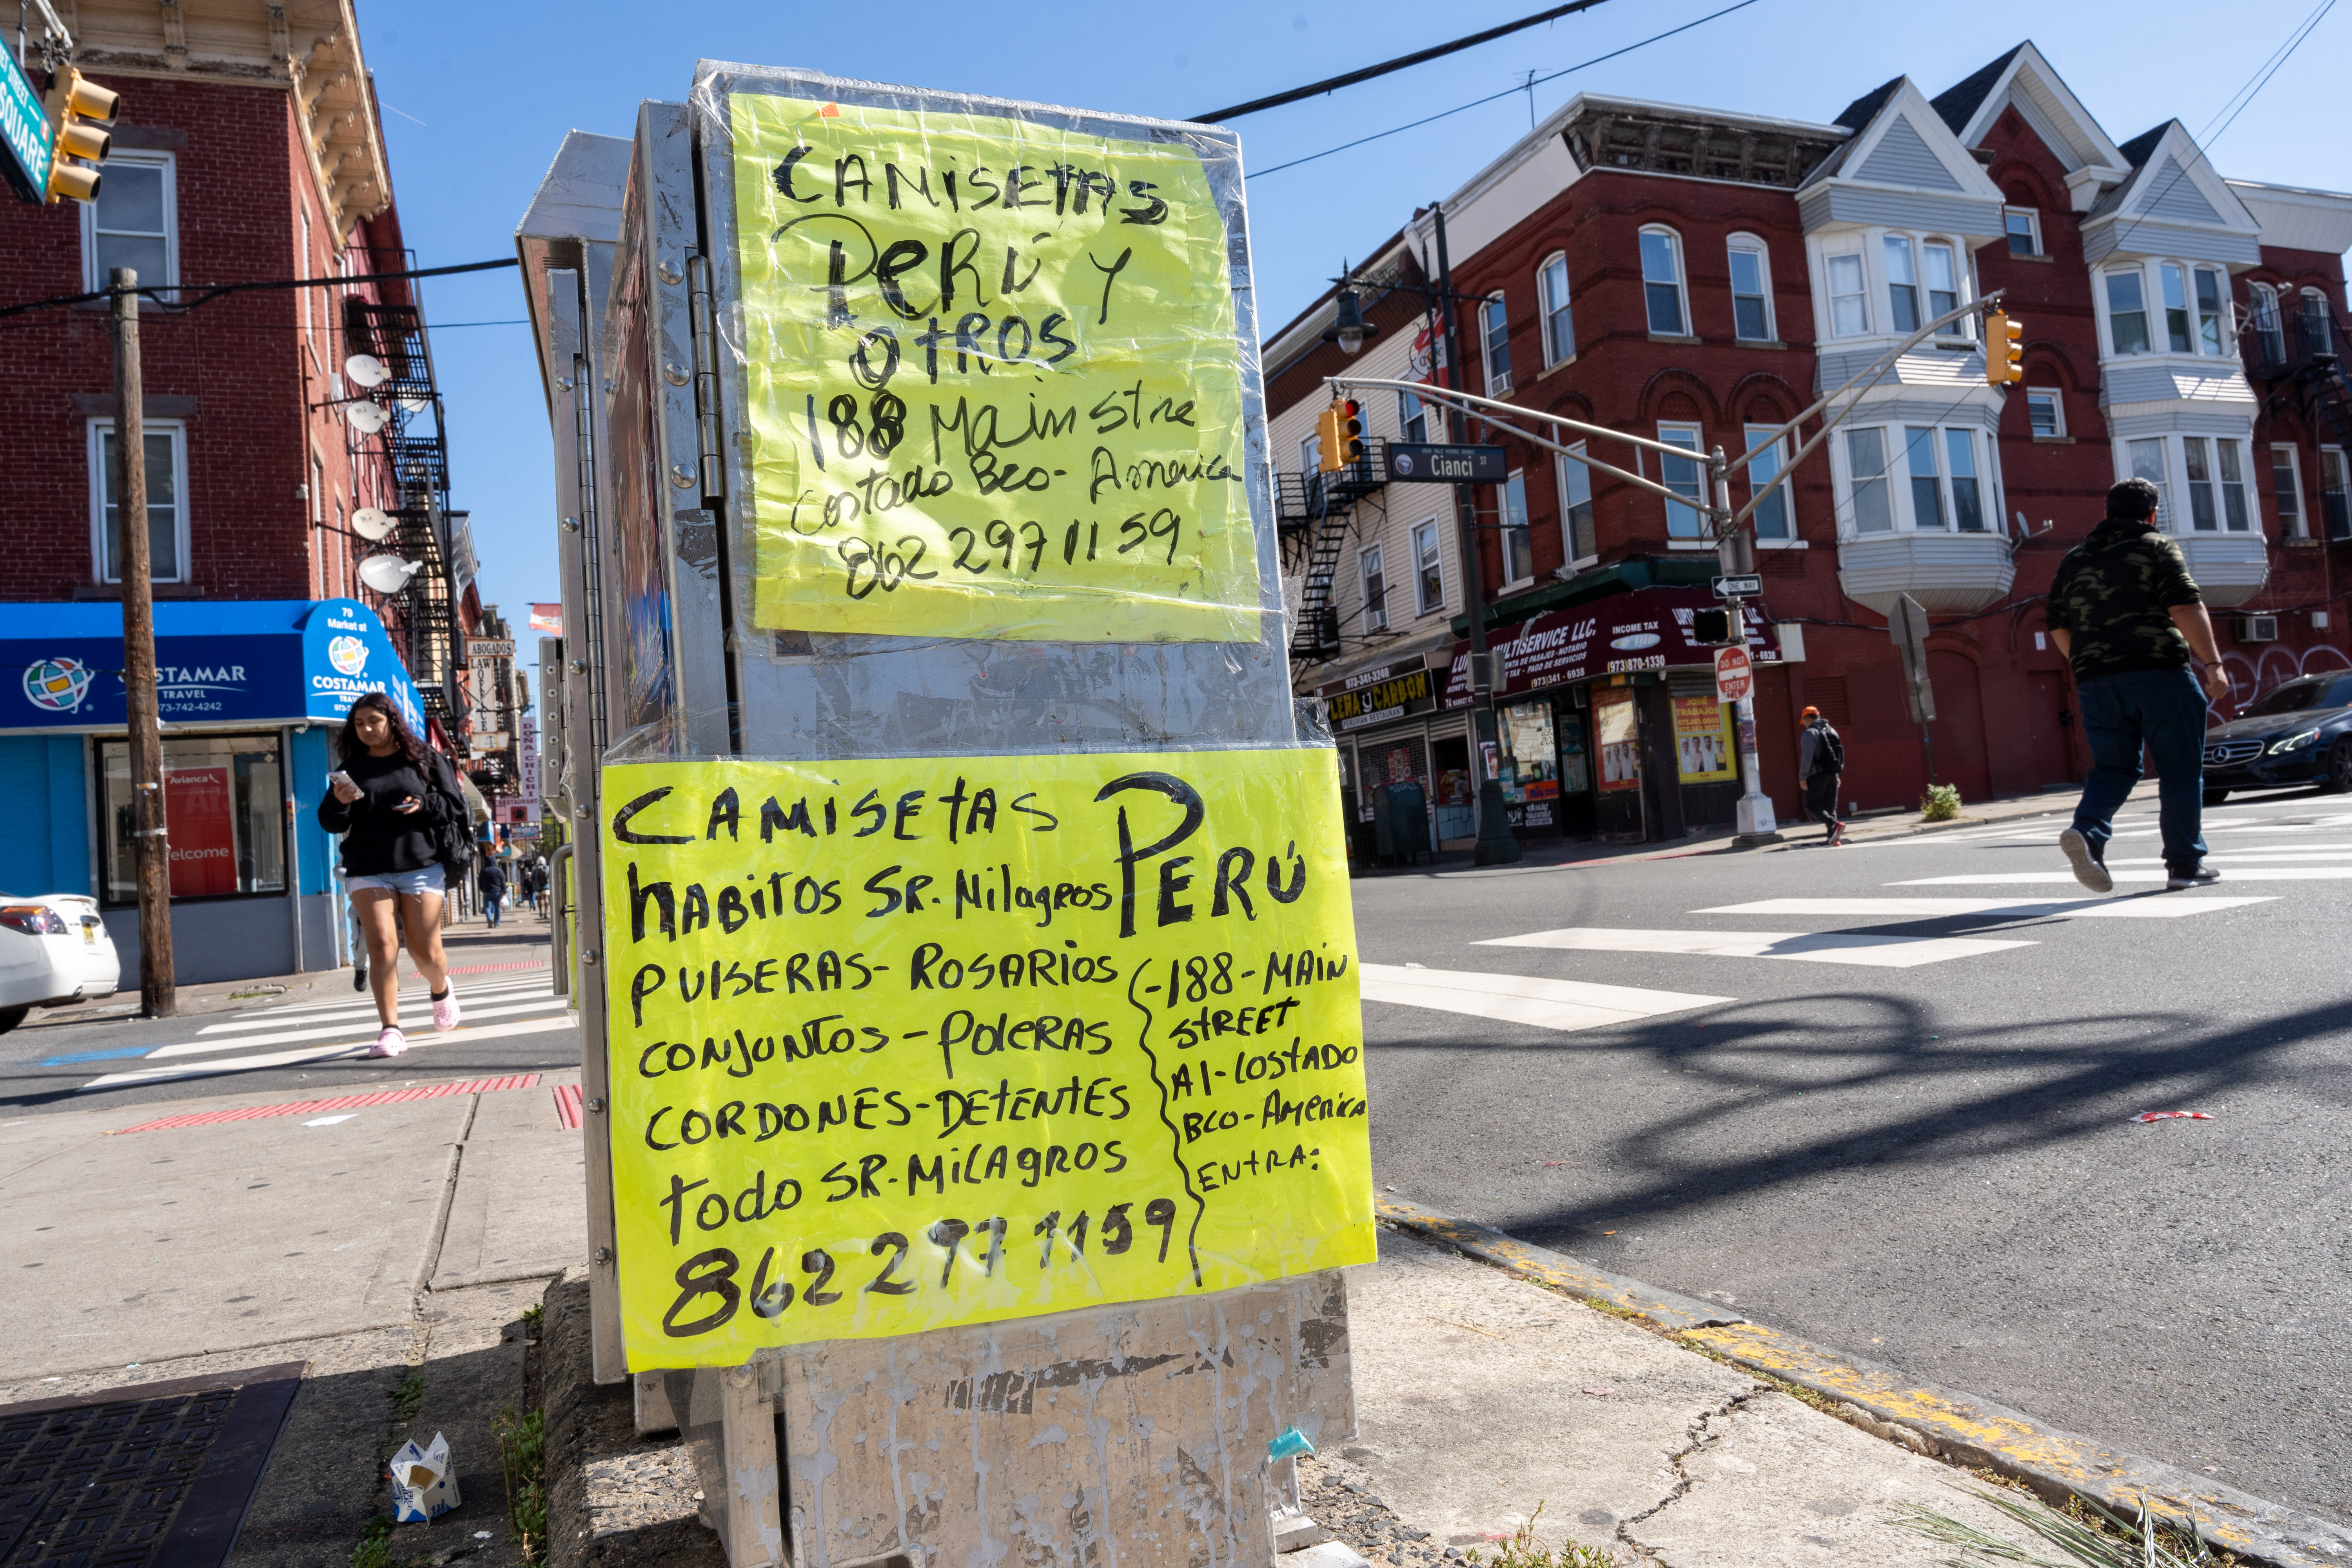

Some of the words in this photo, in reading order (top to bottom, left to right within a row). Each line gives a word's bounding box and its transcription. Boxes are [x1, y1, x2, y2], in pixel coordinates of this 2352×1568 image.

[8, 64, 29, 108] STREET
[0, 81, 46, 183] SQUARE
[807, 389, 907, 472] 188
[930, 393, 1077, 466] Main
[1431, 455, 1473, 476] Cianci
[1480, 456, 1487, 465] ST
[838, 534, 938, 600] 862
[1744, 581, 1756, 589] WAY
[342, 608, 353, 618] 79
[328, 618, 358, 631] Market
[358, 623, 367, 632] st
[1571, 618, 1597, 641] LLC.
[1613, 623, 1642, 634] INCOME
[1644, 621, 1659, 630] TAX
[472, 643, 511, 654] ABOGADOS
[1520, 656, 1528, 666] DE
[1529, 651, 1555, 663] PASAJES
[1558, 641, 1588, 655] NOTARIO
[471, 659, 490, 669] LAW
[1510, 668, 1521, 677] TAX
[1527, 663, 1543, 673] PAGO
[1544, 662, 1553, 670] DE
[1553, 651, 1587, 667] SERVICIOS
[1608, 655, 1665, 673] (973)870-1330
[1720, 659, 1730, 668] DO
[1732, 656, 1744, 665] NOT
[1345, 667, 1390, 690] 973-341-3240
[1567, 667, 1585, 680] 6938
[312, 675, 387, 693] COSTAMAR
[1725, 680, 1745, 690] ENTER
[163, 690, 206, 699] TRAVEL
[1453, 697, 1467, 706] MARKET
[157, 702, 221, 711] 73-742-4242
[1369, 706, 1403, 721] RESTAURANT
[1676, 706, 1719, 716] TRABAJOS
[169, 775, 209, 784] Avianca
[524, 756, 535, 797] CHICHI
[170, 847, 229, 860] elcome
[612, 776, 1058, 844] CAMISETAS
[1094, 771, 1307, 938] PERÚ
[662, 1247, 843, 1338] 862
